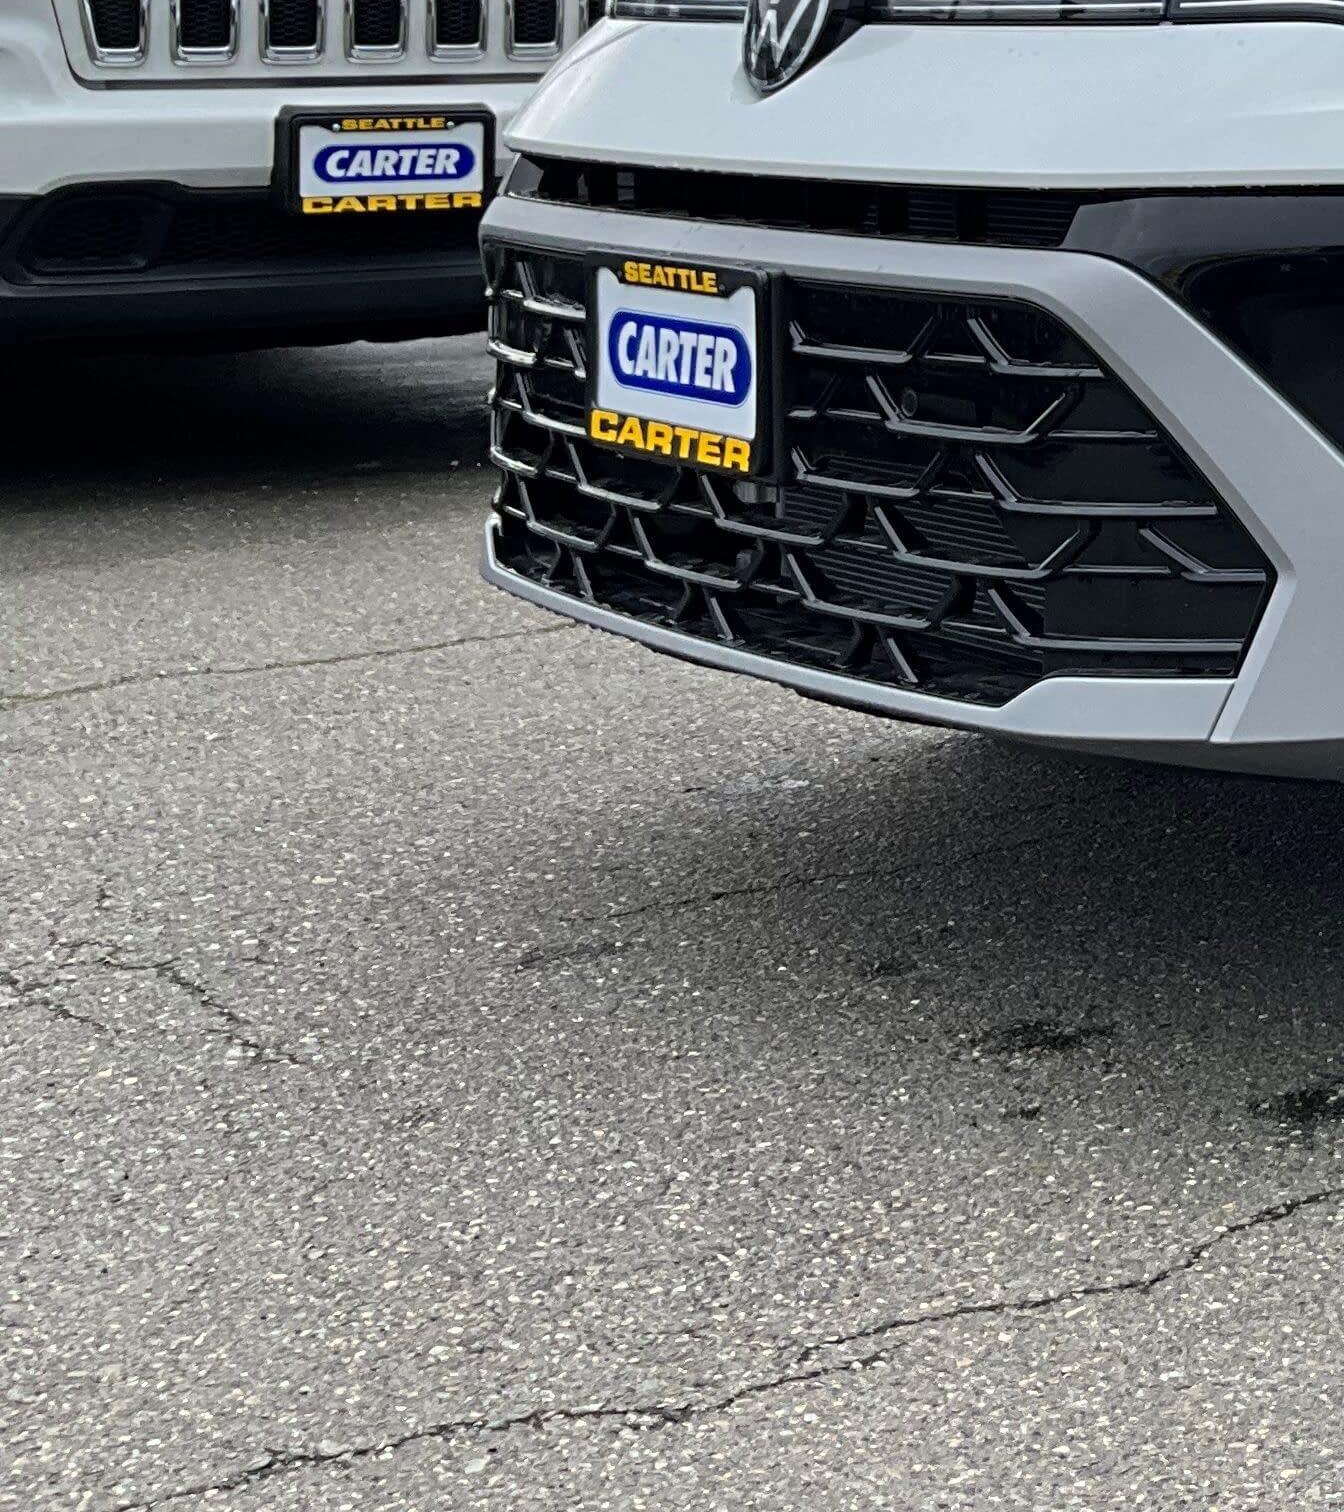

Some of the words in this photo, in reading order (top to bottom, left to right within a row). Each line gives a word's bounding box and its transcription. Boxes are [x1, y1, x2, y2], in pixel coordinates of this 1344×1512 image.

[341, 117, 446, 131] SEATTLE
[325, 148, 460, 178] CARTER
[302, 191, 482, 214] CARTER
[623, 260, 718, 293] SEATTLE
[617, 320, 738, 393] CARTER
[590, 408, 751, 473] CARTER
